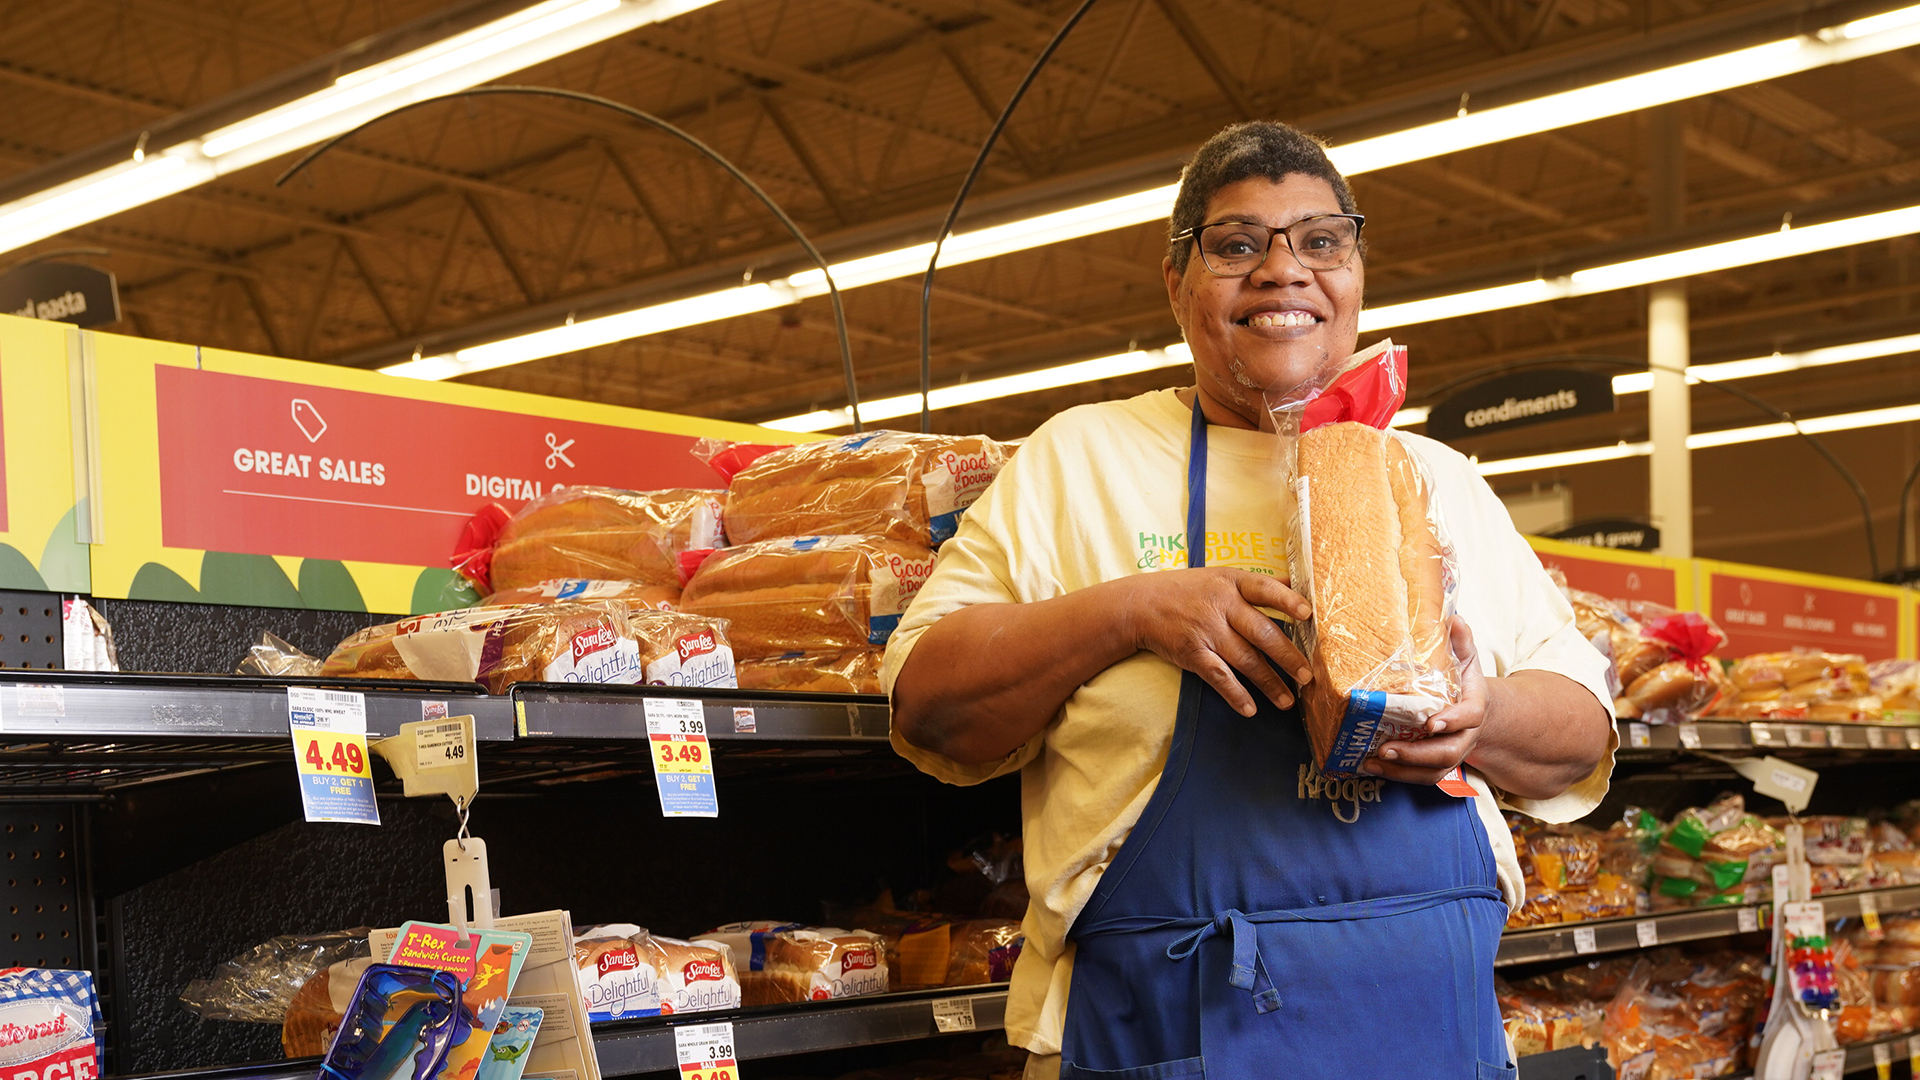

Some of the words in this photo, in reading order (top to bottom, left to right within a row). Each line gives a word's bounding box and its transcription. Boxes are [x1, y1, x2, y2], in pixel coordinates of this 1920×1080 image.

[1464, 389, 1578, 428] condiments
[233, 447, 312, 479] GREAT
[318, 457, 386, 486] SALES
[943, 451, 991, 483] Good
[466, 474, 542, 501] DIGITAL
[962, 473, 993, 488] DOUGH
[1139, 532, 1189, 551] HIK
[1205, 532, 1265, 548] BIKE
[887, 556, 935, 586] Good
[1249, 567, 1275, 576] 2016
[574, 634, 599, 657] Sara
[597, 628, 614, 647] Lee
[680, 638, 700, 658] Sara
[698, 634, 715, 651] Lee
[669, 652, 729, 688] Delightful
[680, 720, 704, 733] 3.99
[670, 734, 688, 742] SALE
[1333, 730, 1350, 756] BREAD
[1338, 719, 1376, 769] WHITE
[306, 740, 364, 774] 4.49
[445, 745, 464, 760] 4.49
[661, 744, 702, 763] 3.49
[312, 776, 330, 785] BUY
[340, 777, 357, 787] GET
[358, 779, 364, 788] 1
[666, 775, 680, 783] BUY
[688, 775, 701, 783] GET
[680, 783, 697, 791] FREE
[330, 786, 352, 796] FREE
[1297, 760, 1386, 824] Kroger
[385, 932, 398, 940] toa
[408, 932, 447, 950] T-Rex
[401, 947, 440, 961] Sandwich
[441, 952, 471, 964] Cutter
[600, 953, 623, 971] Sara
[622, 951, 638, 967] Lee
[843, 953, 864, 969] Sara
[863, 952, 875, 966] Lee
[686, 963, 710, 980] Sara
[588, 970, 650, 1017] Delightful
[832, 971, 885, 998] Delightful
[676, 984, 732, 1012] Delightful
[957, 1016, 973, 1026] 1.79
[709, 1045, 733, 1059] 3.99
[700, 1061, 717, 1070] SALE
